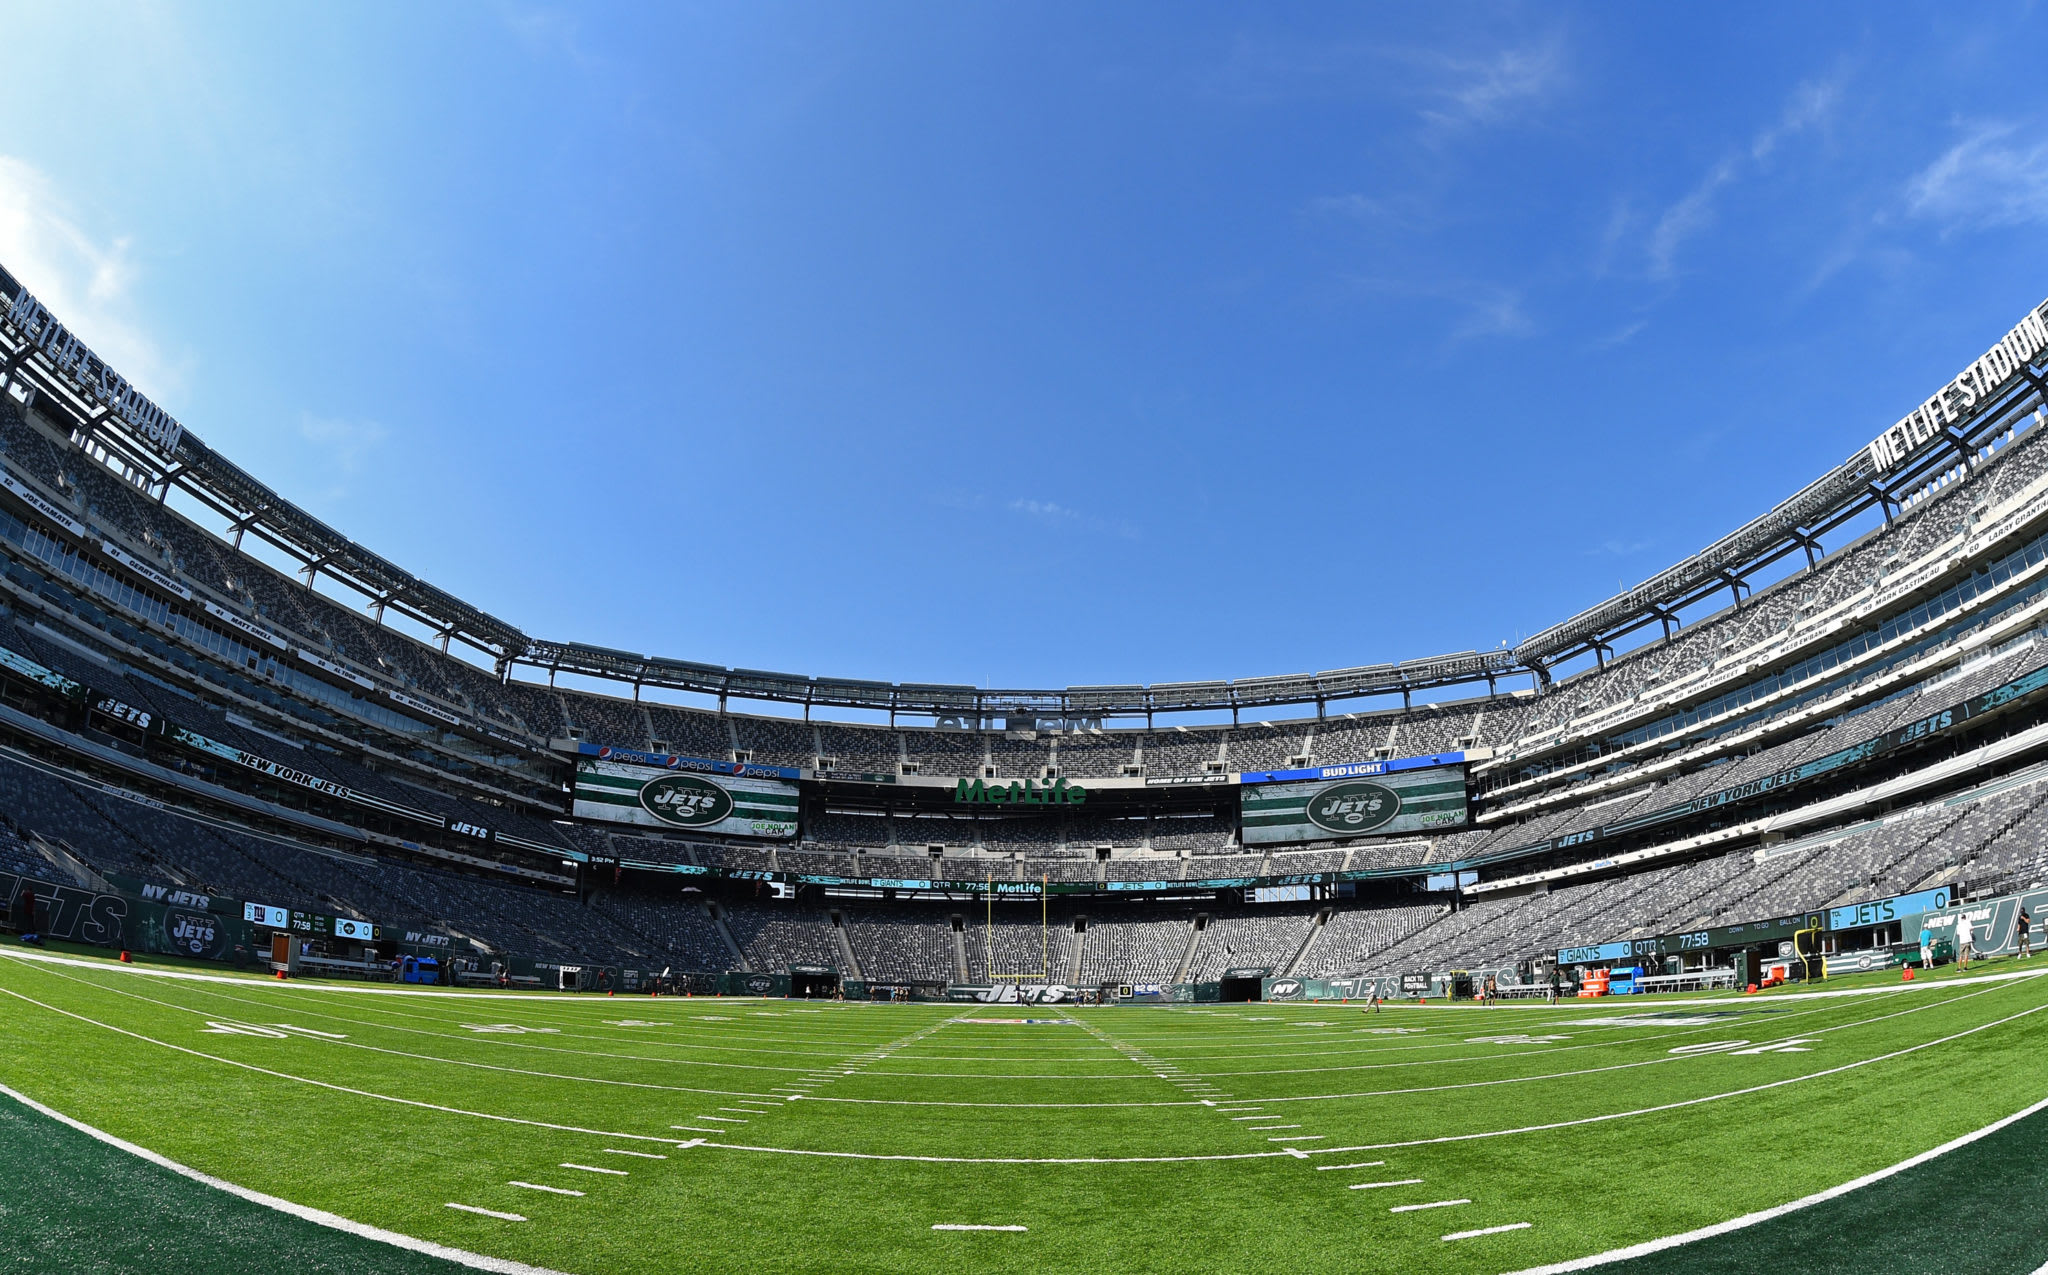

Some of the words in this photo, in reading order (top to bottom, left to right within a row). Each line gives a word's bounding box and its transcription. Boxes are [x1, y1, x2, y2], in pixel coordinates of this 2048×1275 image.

[9, 285, 98, 384] METLIFE
[95, 365, 183, 453] STADIUM
[1869, 386, 1958, 473] METLIFE
[1956, 308, 2048, 407] STADIUM
[3, 477, 14, 488] 12
[22, 491, 38, 504] JOE
[38, 500, 72, 528] NAMATH
[1988, 522, 2014, 541] LARRY
[1875, 591, 1897, 607] MARK
[1898, 566, 1940, 594] GASTINEAU
[230, 615, 252, 632] MATT
[251, 626, 272, 641] SNELL
[97, 698, 151, 729] JETS
[1900, 710, 1952, 743] JETS
[613, 751, 647, 764] pepsi
[680, 758, 713, 772] pepsi
[237, 751, 272, 772] NEW
[272, 763, 314, 787] YORK
[314, 777, 350, 798] JETS
[746, 765, 780, 778] pepsi
[1322, 767, 1349, 778] BUD
[1349, 763, 1382, 776] LIGHT
[955, 777, 1087, 804] MetLife
[1689, 796, 1721, 812] NEW
[1723, 783, 1762, 803] YORK
[1766, 767, 1803, 790] JETS
[654, 790, 716, 808] JETS
[1321, 799, 1382, 815] JETS
[1436, 817, 1455, 825] CAM
[1438, 810, 1464, 820] NOLAN
[451, 821, 488, 839] JETS
[1557, 831, 1594, 848] JETS
[729, 869, 774, 881] JETS
[1278, 873, 1322, 885] JETS
[933, 881, 951, 889] QTR
[997, 883, 1042, 893] MetLife
[1119, 882, 1145, 890] JETS
[141, 883, 168, 900] NY
[168, 890, 210, 909] JETS
[275, 911, 283, 922] 0
[293, 911, 304, 919] QTR
[1850, 900, 1894, 926] JETS
[1935, 892, 1946, 910] 0
[292, 919, 311, 931] 77:58
[1779, 918, 1792, 926] BALL
[1810, 916, 1818, 928] 0
[1927, 914, 1956, 929] NEW
[173, 920, 215, 941] JETS
[362, 925, 369, 936] 0
[1728, 926, 1744, 934] DOWN
[405, 931, 422, 942] NY
[422, 934, 450, 946] JETS
[1679, 932, 1709, 949] 77:58
[1566, 946, 1600, 962] GIANTS
[1623, 943, 1630, 955] 0
[1635, 939, 1657, 955] QTR
[975, 984, 1068, 1003] JETS
[1272, 983, 1298, 994] NY
[1345, 977, 1401, 999] JETS
